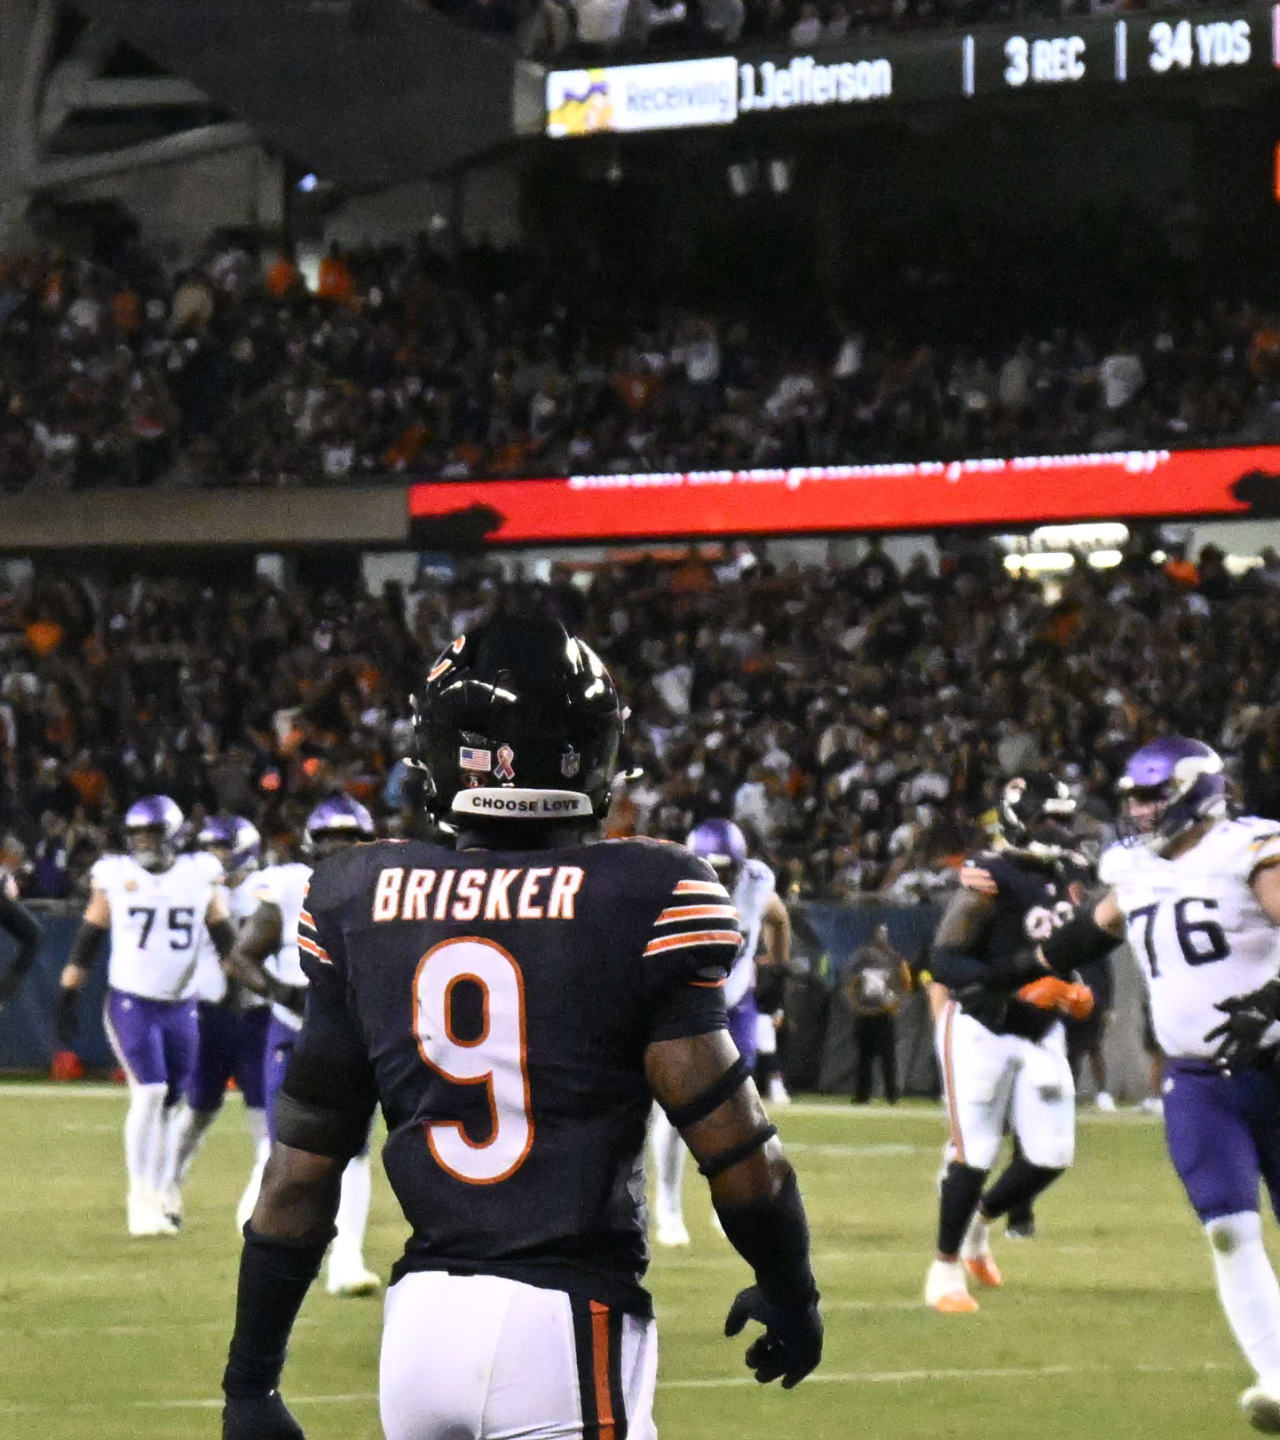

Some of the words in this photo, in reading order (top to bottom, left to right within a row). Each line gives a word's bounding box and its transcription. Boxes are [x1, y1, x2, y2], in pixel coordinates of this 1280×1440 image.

[1004, 35, 1029, 86] 3
[1031, 36, 1086, 82] REC
[1148, 20, 1192, 72] 34
[1196, 20, 1251, 66] YDS
[472, 796, 536, 813] CHOOSE
[543, 799, 579, 813] LOVE
[372, 866, 585, 922] BRISKER
[127, 907, 195, 951] 75
[1128, 898, 1232, 977] 76
[413, 936, 535, 1185] 9
